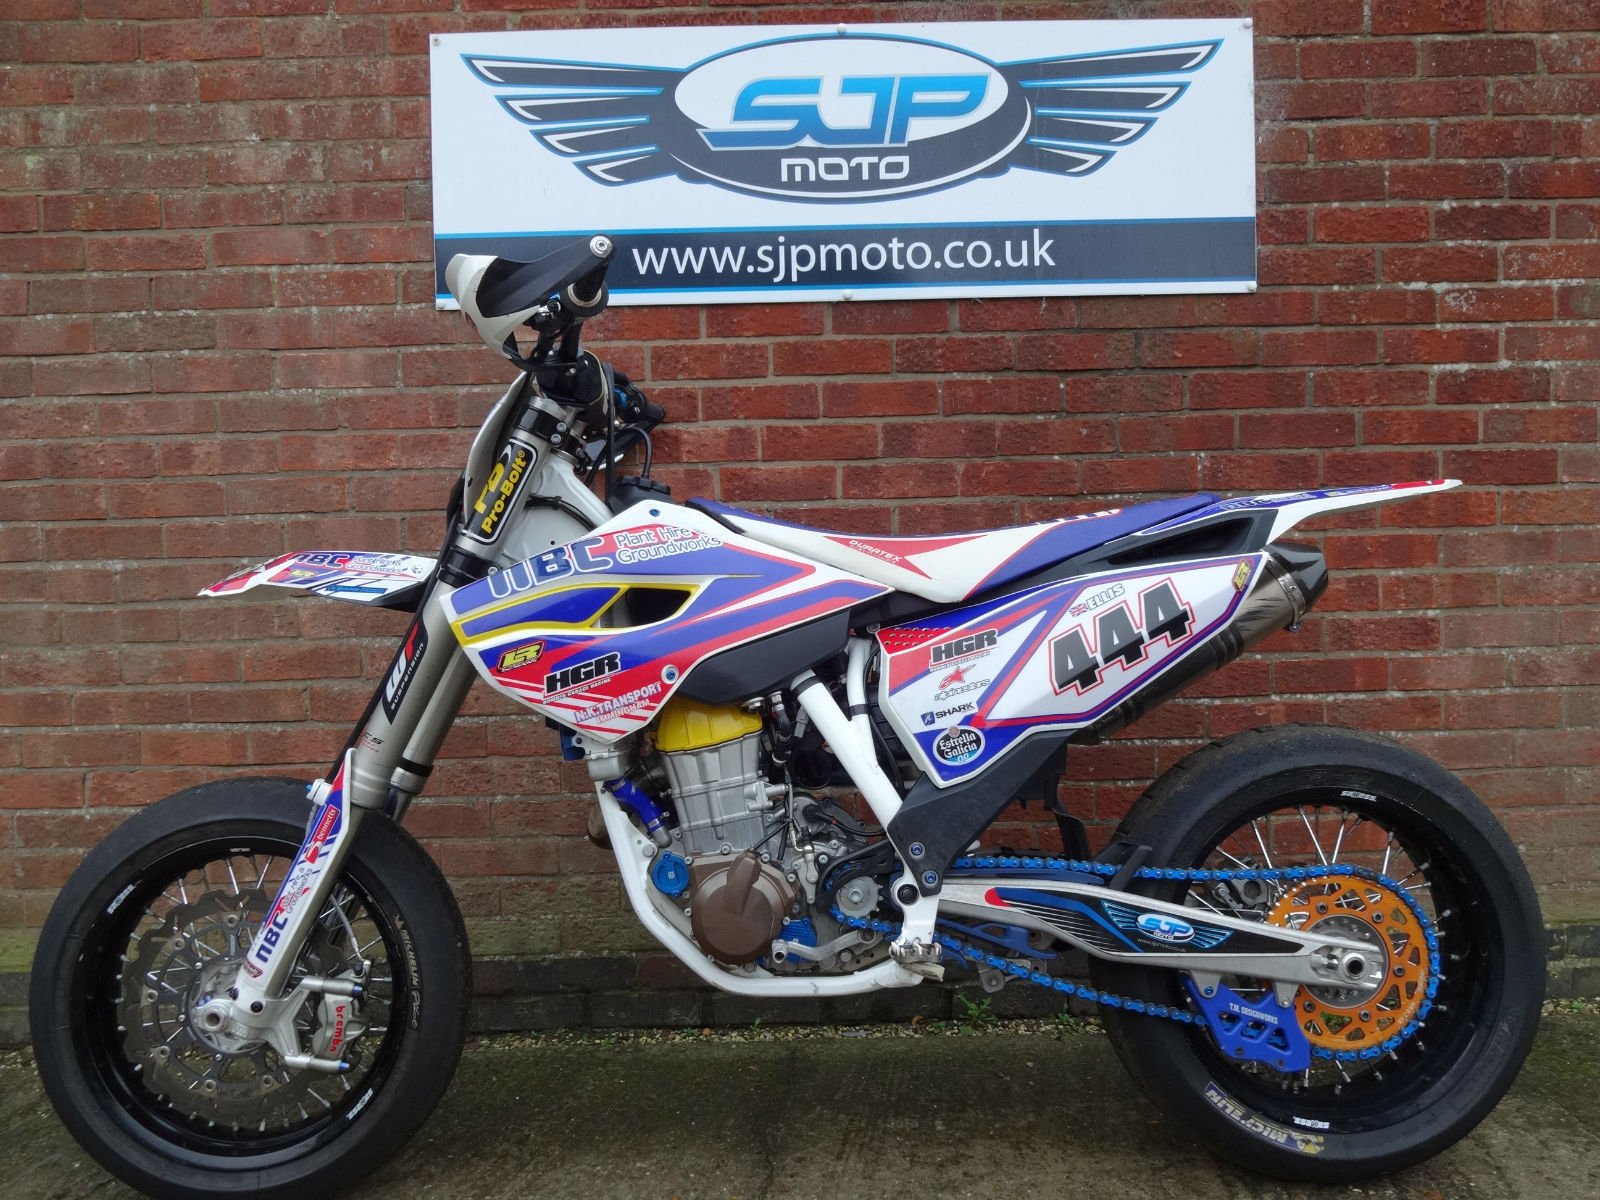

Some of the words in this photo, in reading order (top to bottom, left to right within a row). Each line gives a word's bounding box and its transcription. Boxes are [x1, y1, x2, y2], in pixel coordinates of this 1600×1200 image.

[696, 73, 991, 150] SJP
[781, 156, 909, 181] MOTO
[632, 229, 1056, 282] www.sjpmoto.co.uk
[616, 530, 658, 547] Plant
[660, 527, 690, 541] Hire
[616, 537, 721, 563] Groundworks
[1086, 583, 1125, 610] ELLIS
[932, 629, 997, 664] HGR
[1051, 579, 1192, 692] 444
[545, 653, 620, 694] HGR
[598, 699, 650, 724] IMMINGHAM
[935, 702, 975, 719] SHARK
[940, 731, 976, 750] Estrella
[943, 742, 977, 759] Galicia
[317, 808, 337, 840] bennetts
[1141, 917, 1191, 936] SJP
[401, 929, 420, 987] MICHELIN
